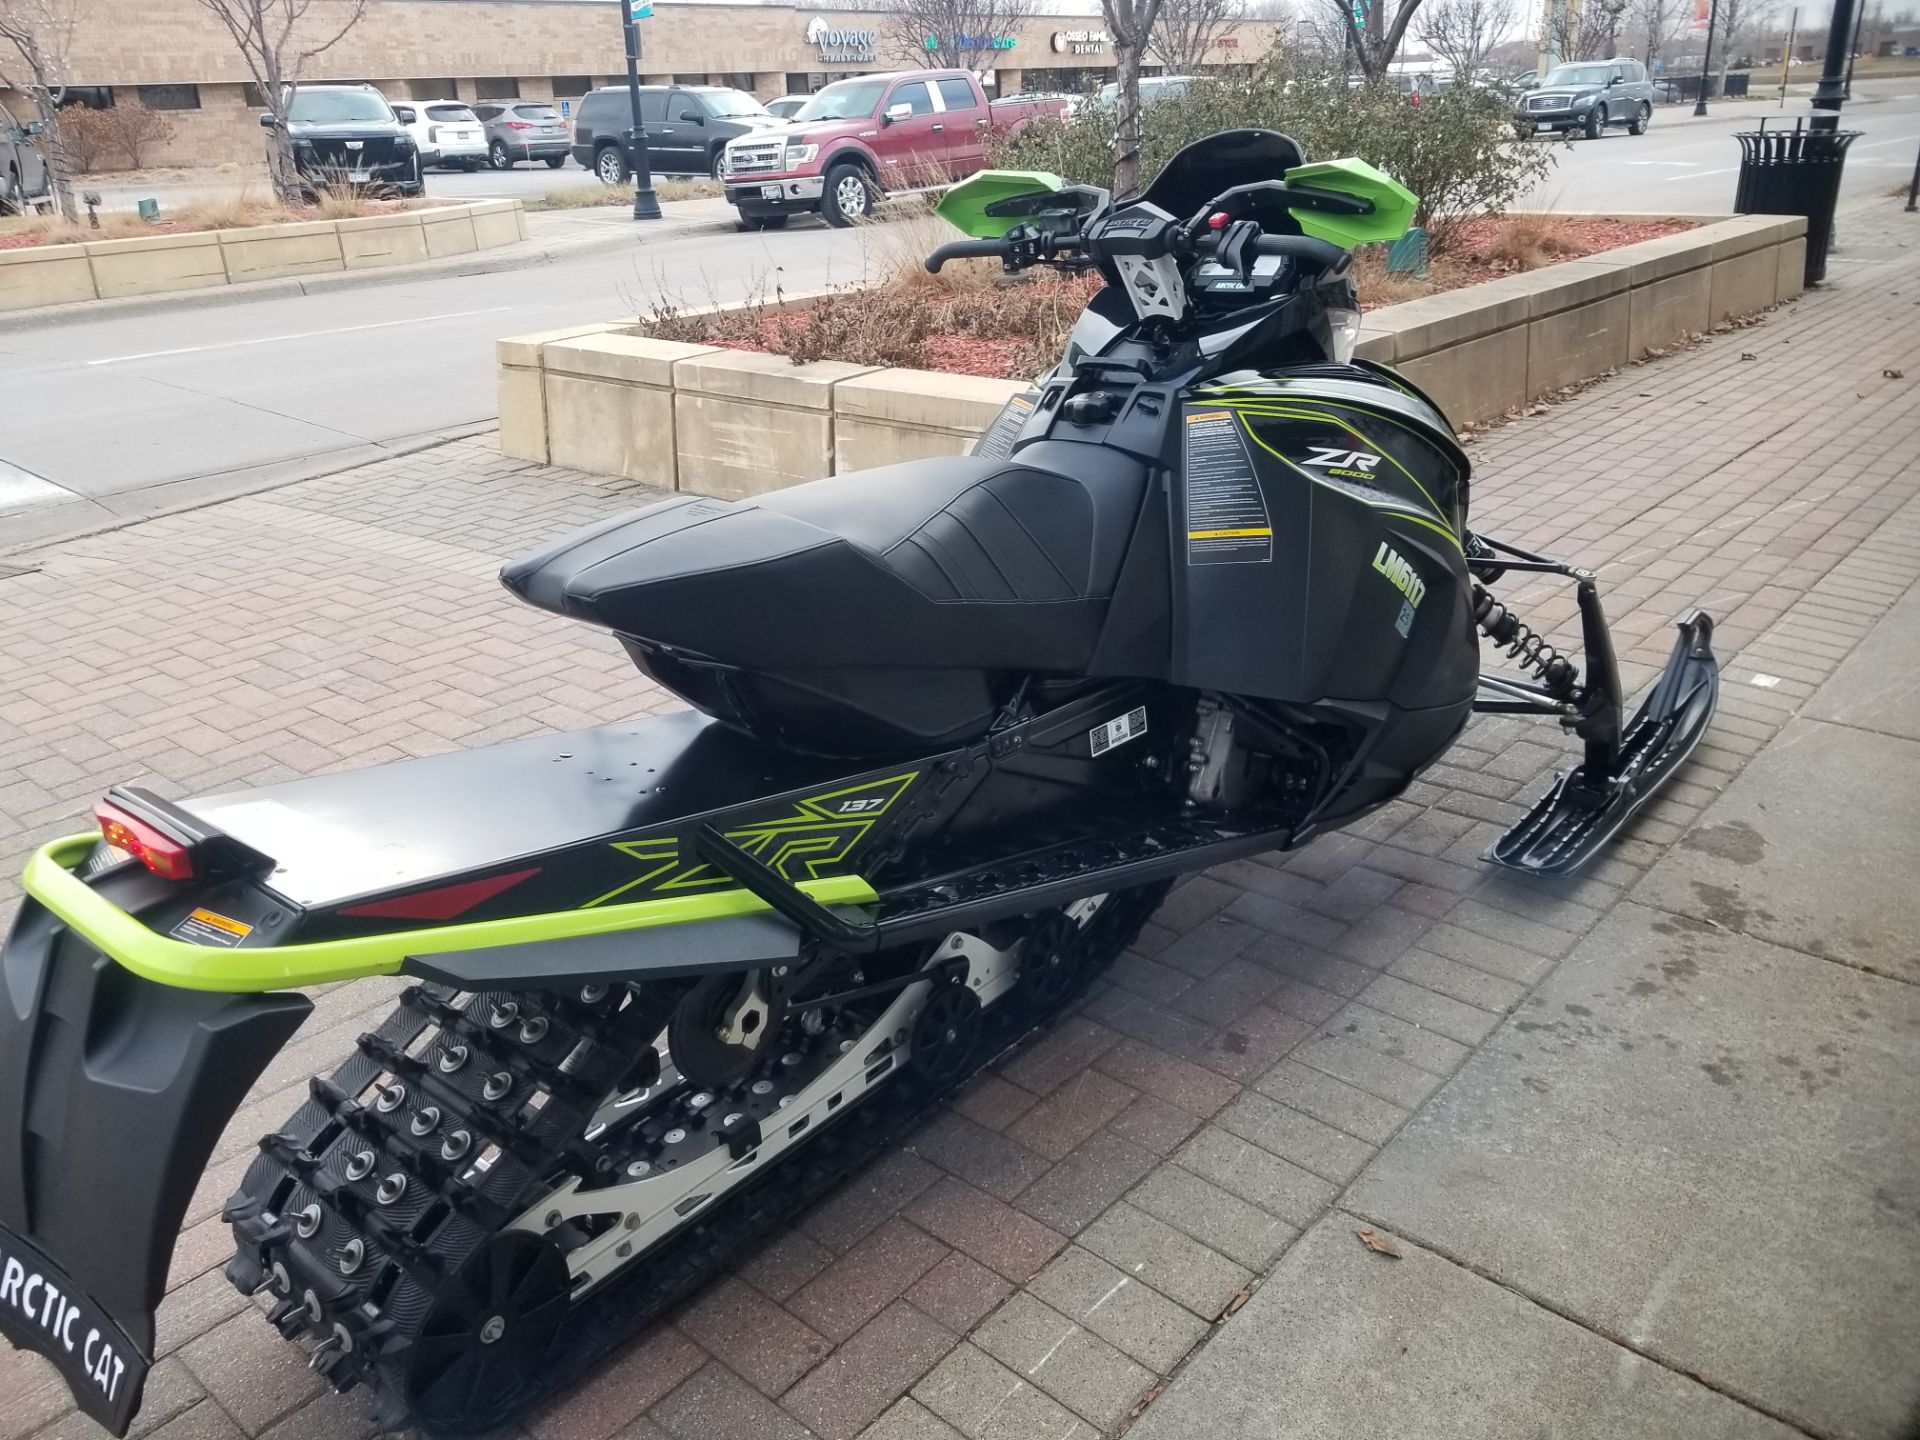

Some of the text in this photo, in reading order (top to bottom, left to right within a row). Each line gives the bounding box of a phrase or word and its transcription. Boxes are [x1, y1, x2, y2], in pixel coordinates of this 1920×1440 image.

[1066, 31, 1088, 41] OSSEO
[1075, 44, 1103, 54] DENTAL
[1300, 446, 1382, 472] ZR
[1372, 541, 1426, 609] LM6117
[838, 798, 885, 812] 137
[0, 1256, 125, 1402] RCTIC CAT
